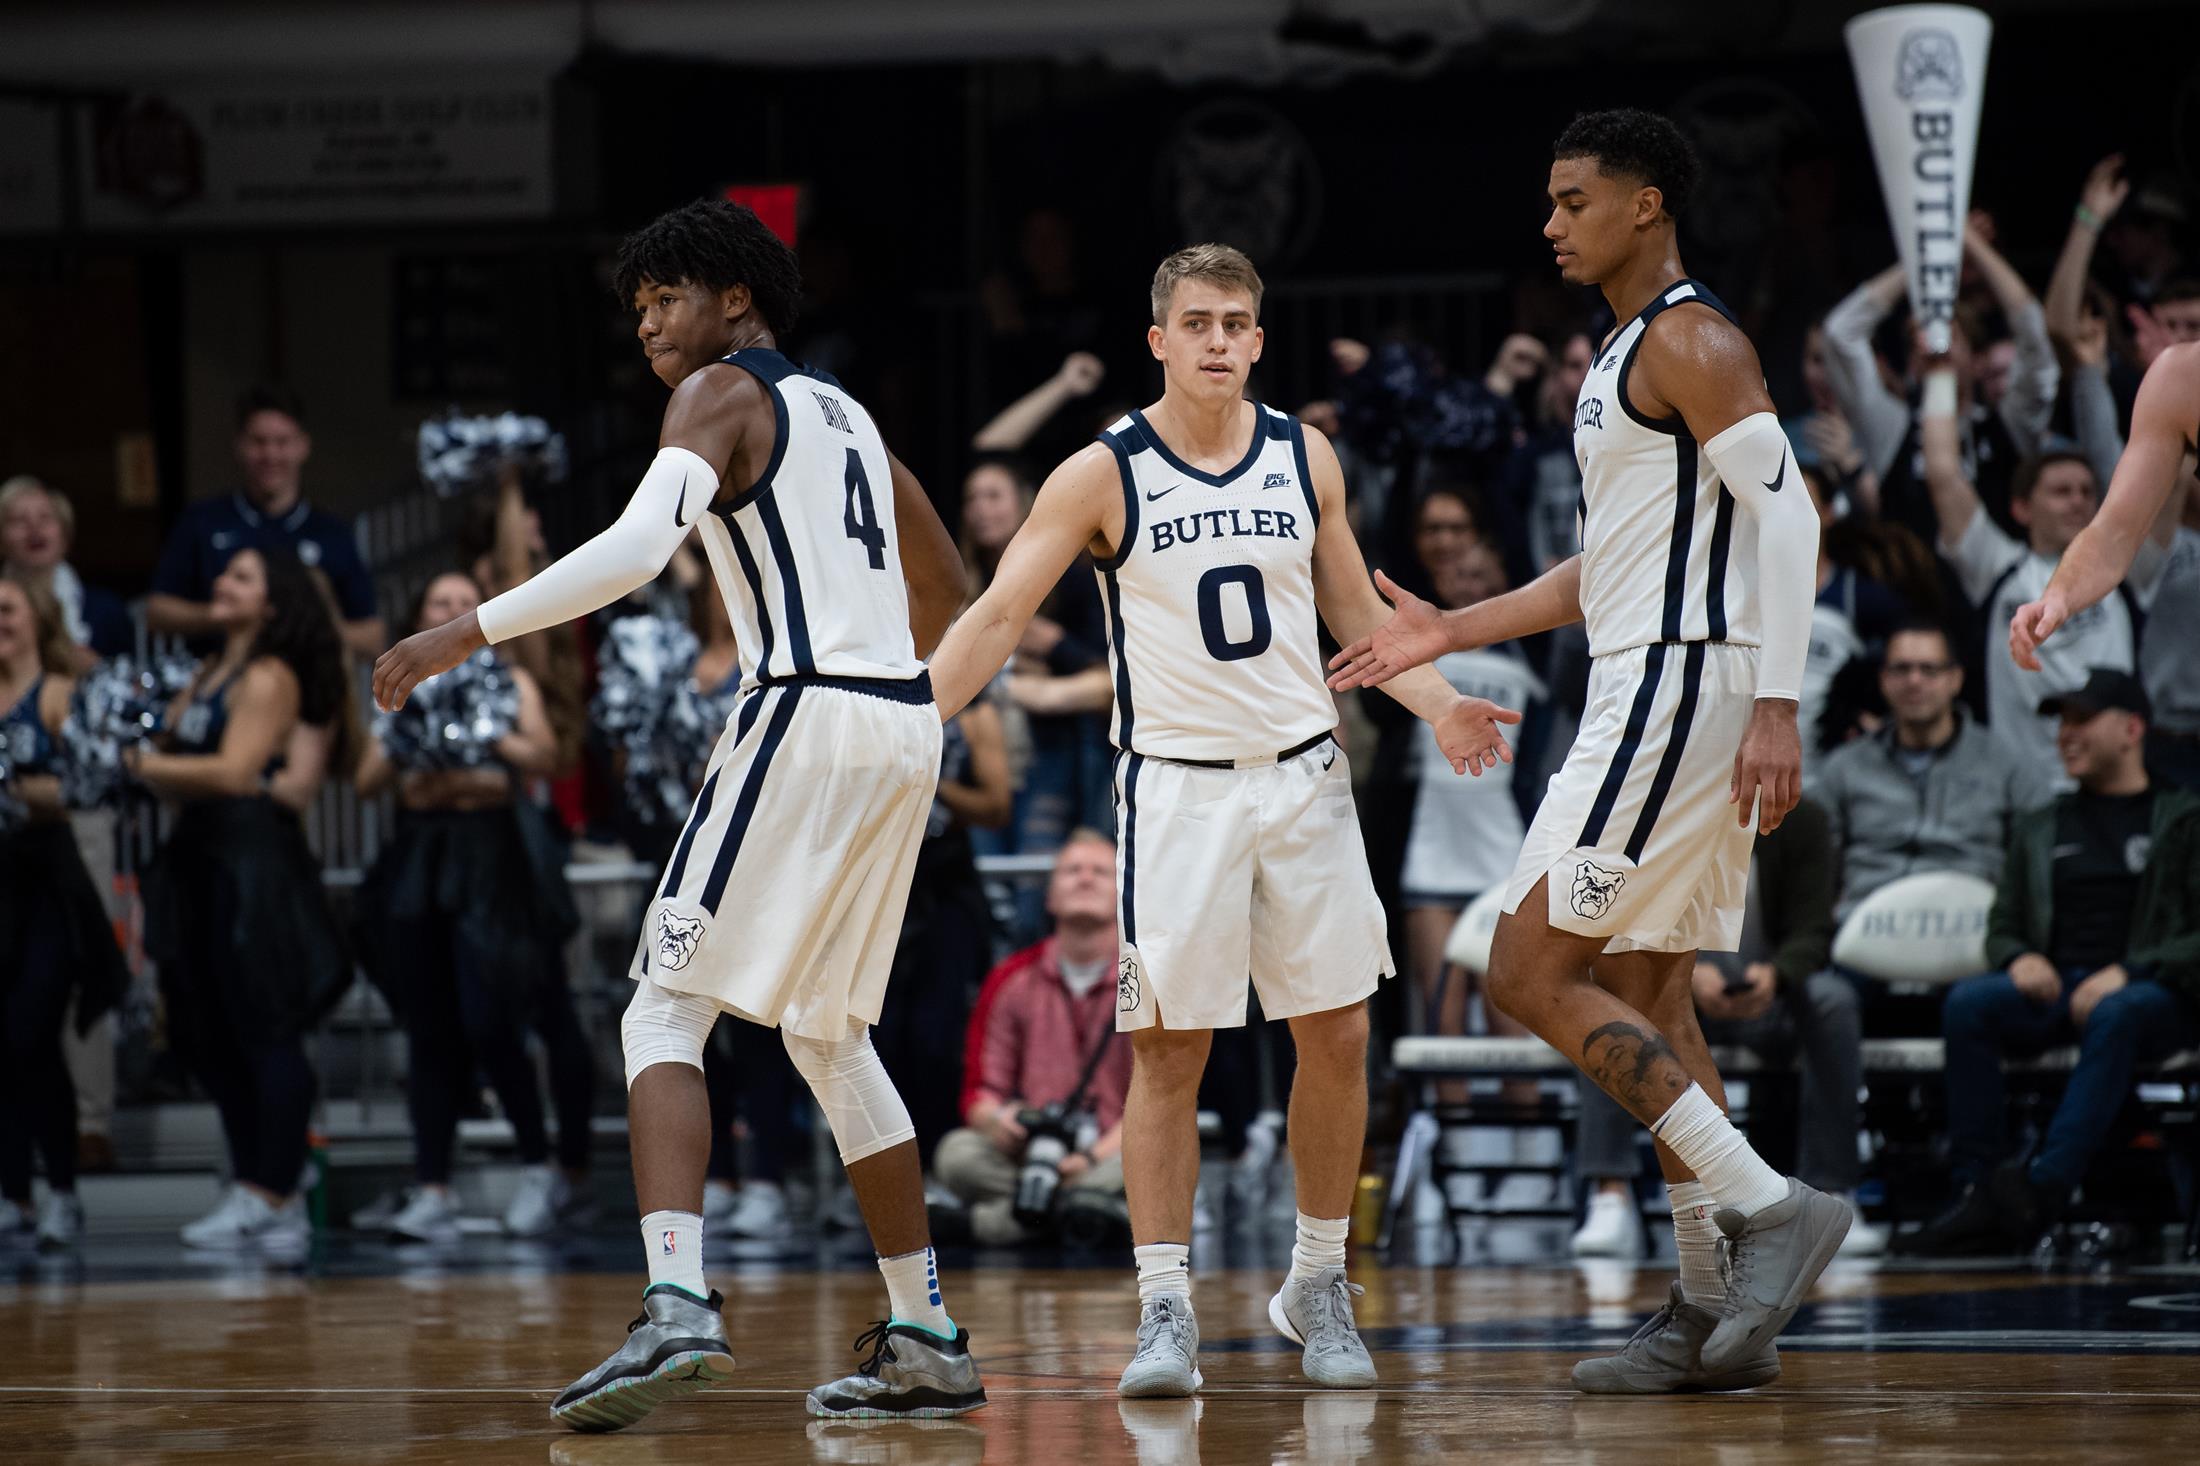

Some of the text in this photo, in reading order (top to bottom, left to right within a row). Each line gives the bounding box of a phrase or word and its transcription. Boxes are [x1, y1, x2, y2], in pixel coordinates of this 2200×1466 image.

[1573, 397, 1603, 433] UTLER
[1264, 479, 1292, 487] EAST
[1265, 473, 1286, 481] BIG
[844, 447, 886, 571] 4
[1150, 509, 1300, 553] BUTLER
[1197, 564, 1272, 662] 0
